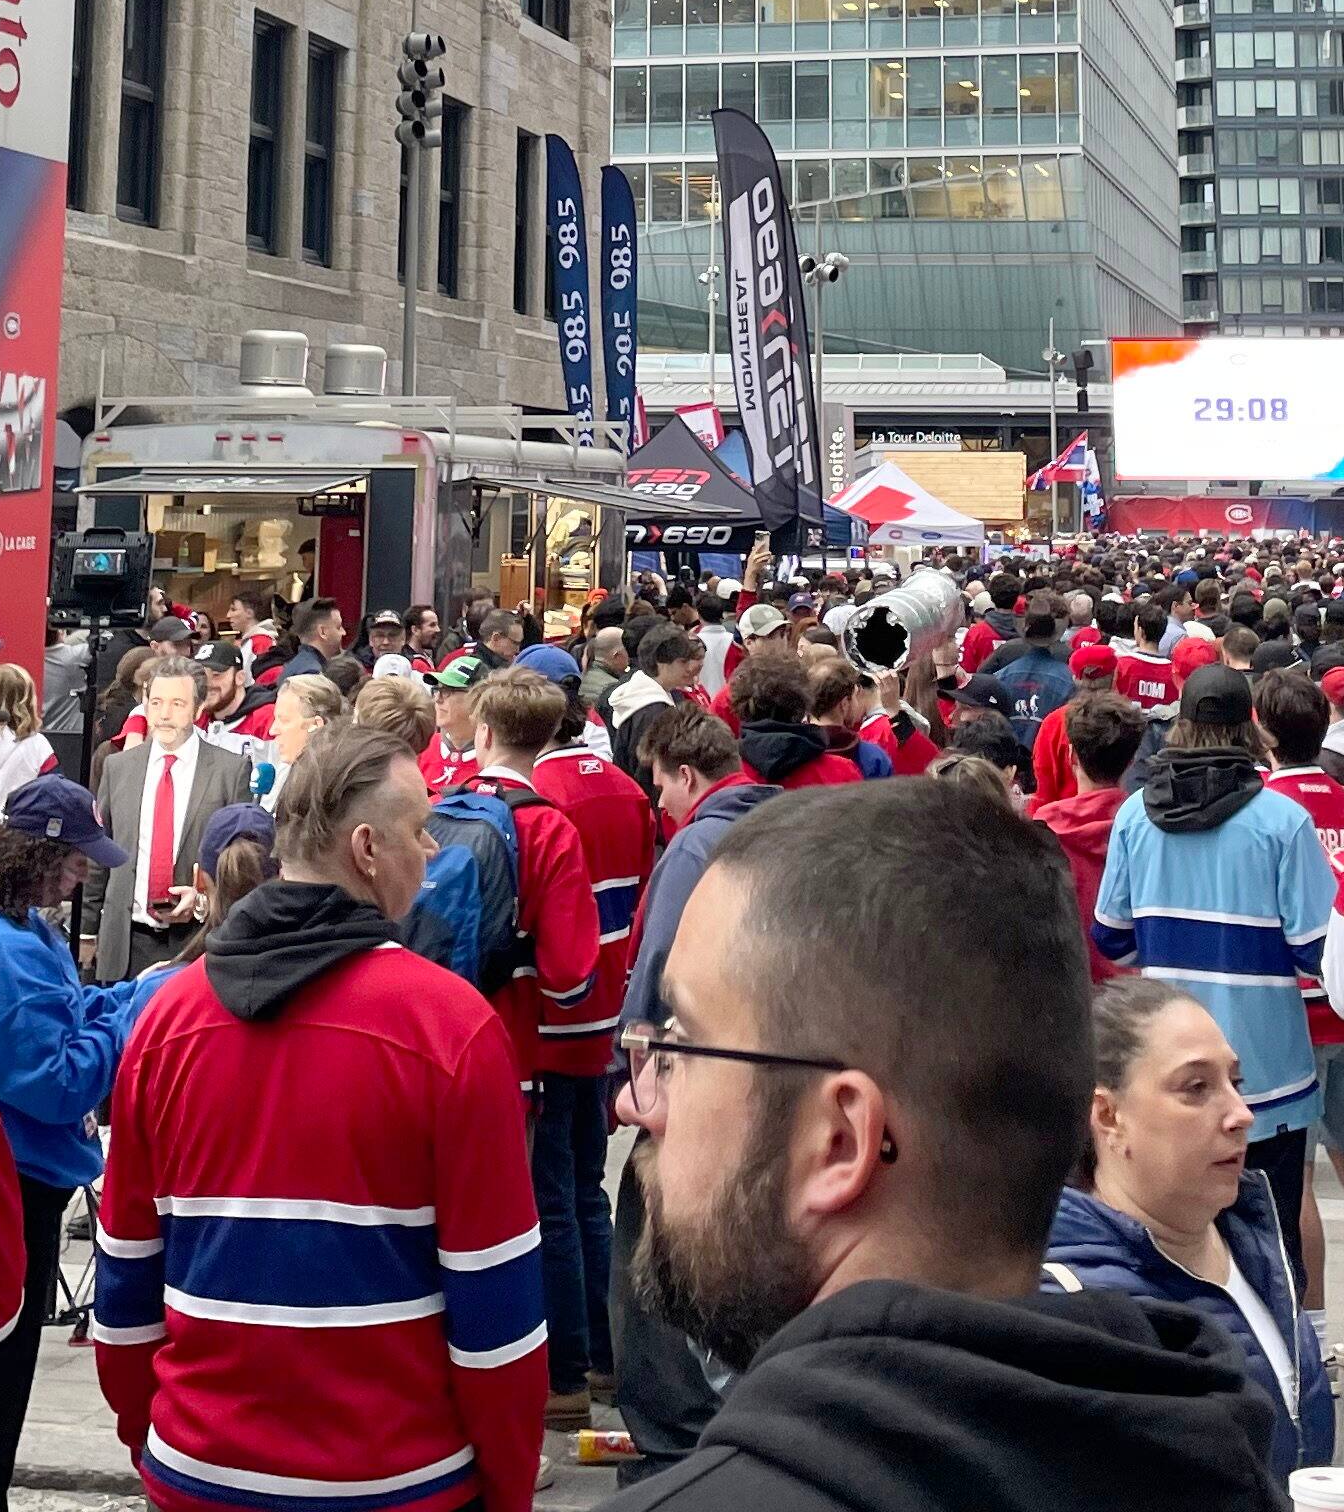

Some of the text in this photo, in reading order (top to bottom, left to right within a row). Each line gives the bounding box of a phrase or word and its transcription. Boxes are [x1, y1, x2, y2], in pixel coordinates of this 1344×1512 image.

[557, 197, 580, 269] 98.5
[610, 223, 633, 290] 98.5
[562, 289, 588, 363] 98.5
[1194, 397, 1289, 423] 29:08
[871, 431, 962, 444] La Tour Deloitte
[829, 426, 846, 499] eloitte.
[662, 525, 733, 546] 690
[1138, 679, 1166, 700] DOMI
